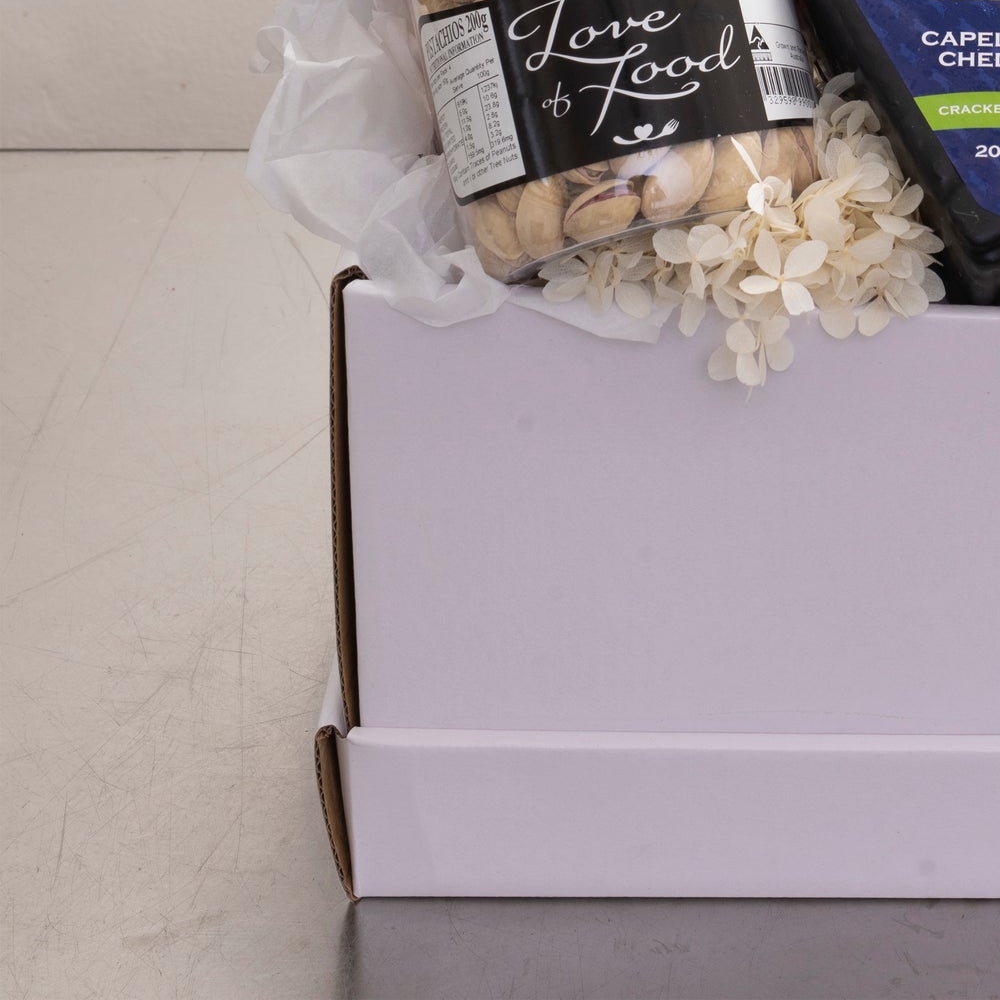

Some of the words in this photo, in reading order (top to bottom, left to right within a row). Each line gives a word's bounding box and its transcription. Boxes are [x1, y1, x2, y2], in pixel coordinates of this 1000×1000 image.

[465, 10, 489, 32] 200g
[579, 24, 741, 137] Food
[542, 81, 571, 118] of
[492, 143, 517, 157] Peanuts
[503, 153, 519, 164] Nuts
